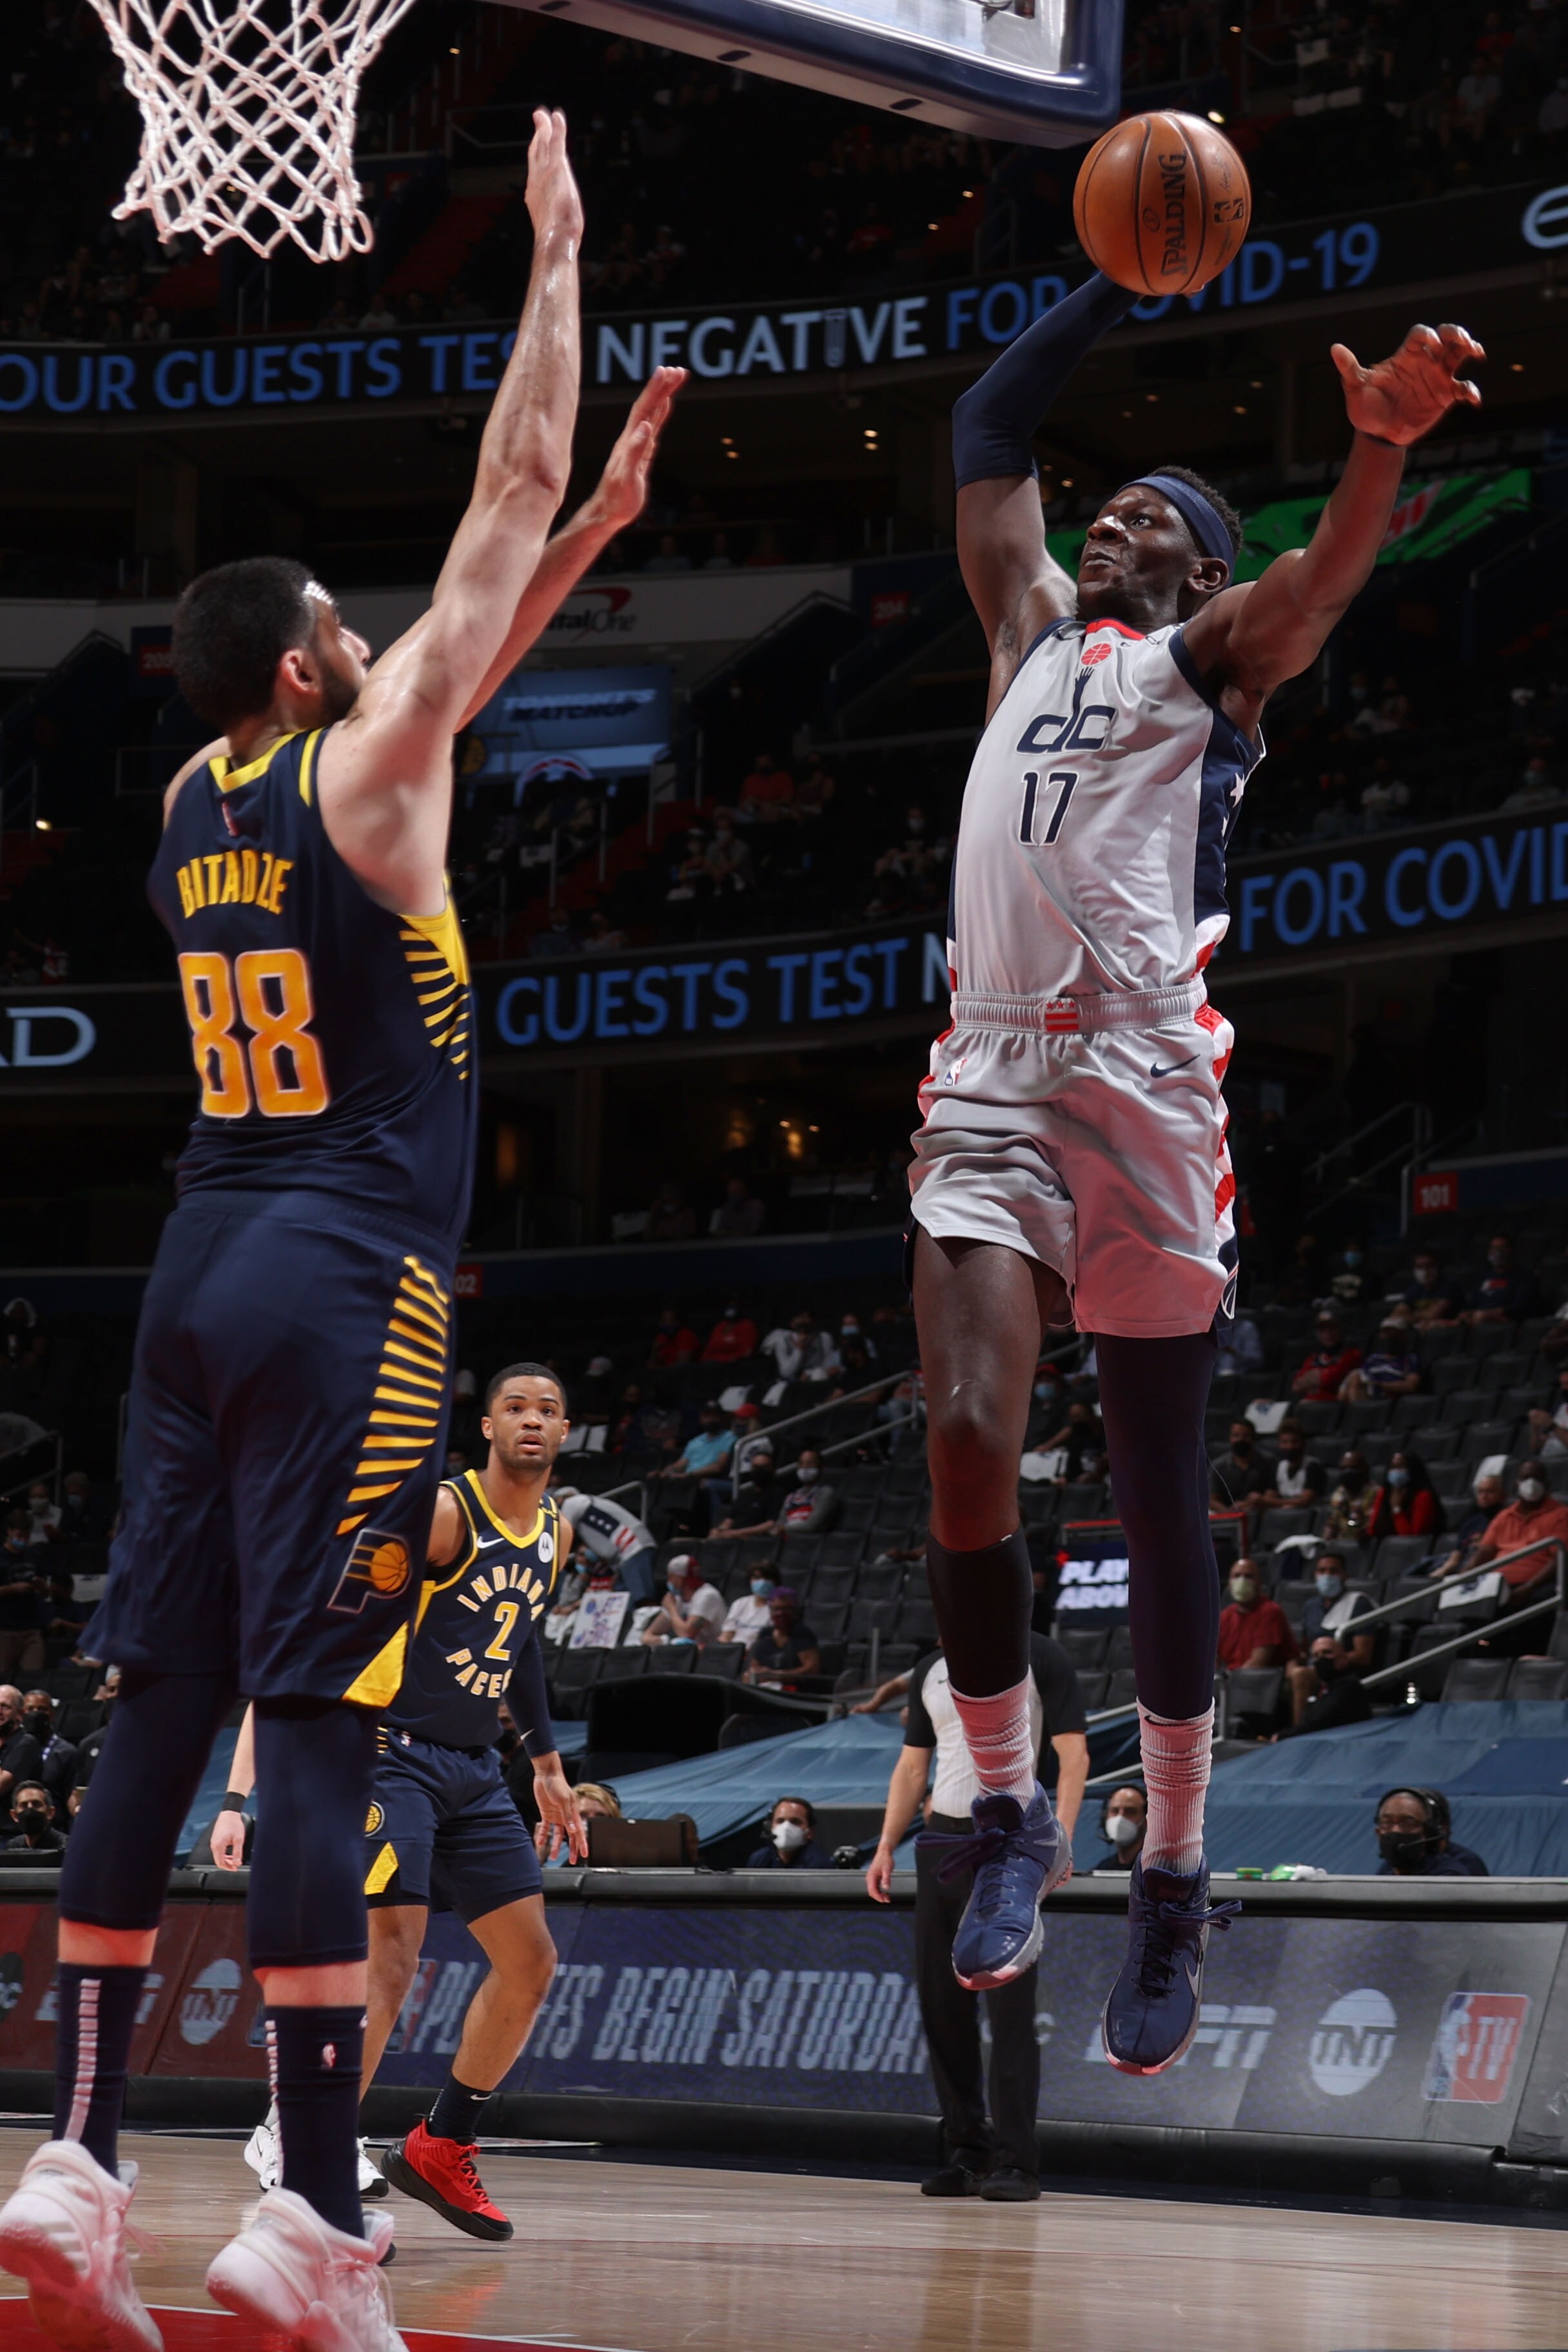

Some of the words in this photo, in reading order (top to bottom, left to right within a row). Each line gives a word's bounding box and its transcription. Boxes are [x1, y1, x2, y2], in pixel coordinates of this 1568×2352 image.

[1159, 150, 1188, 276] SPALDING
[153, 338, 402, 409] GUESTS
[418, 329, 518, 393] TE
[1091, 221, 1380, 322] ID-19
[1019, 770, 1080, 847] 17
[176, 849, 294, 919] BITADZE
[1238, 858, 1369, 953] FOR
[177, 948, 331, 1119] 88
[495, 959, 750, 1046] GUESTS
[767, 937, 910, 1024] TEST
[1420, 1182, 1450, 1209] 101
[456, 1563, 545, 1622] INDIANA
[484, 1600, 521, 1661] 2
[445, 1647, 514, 1698] PACE
[591, 1966, 735, 2064] BEGIN
[720, 1968, 930, 2075] SATURDA
